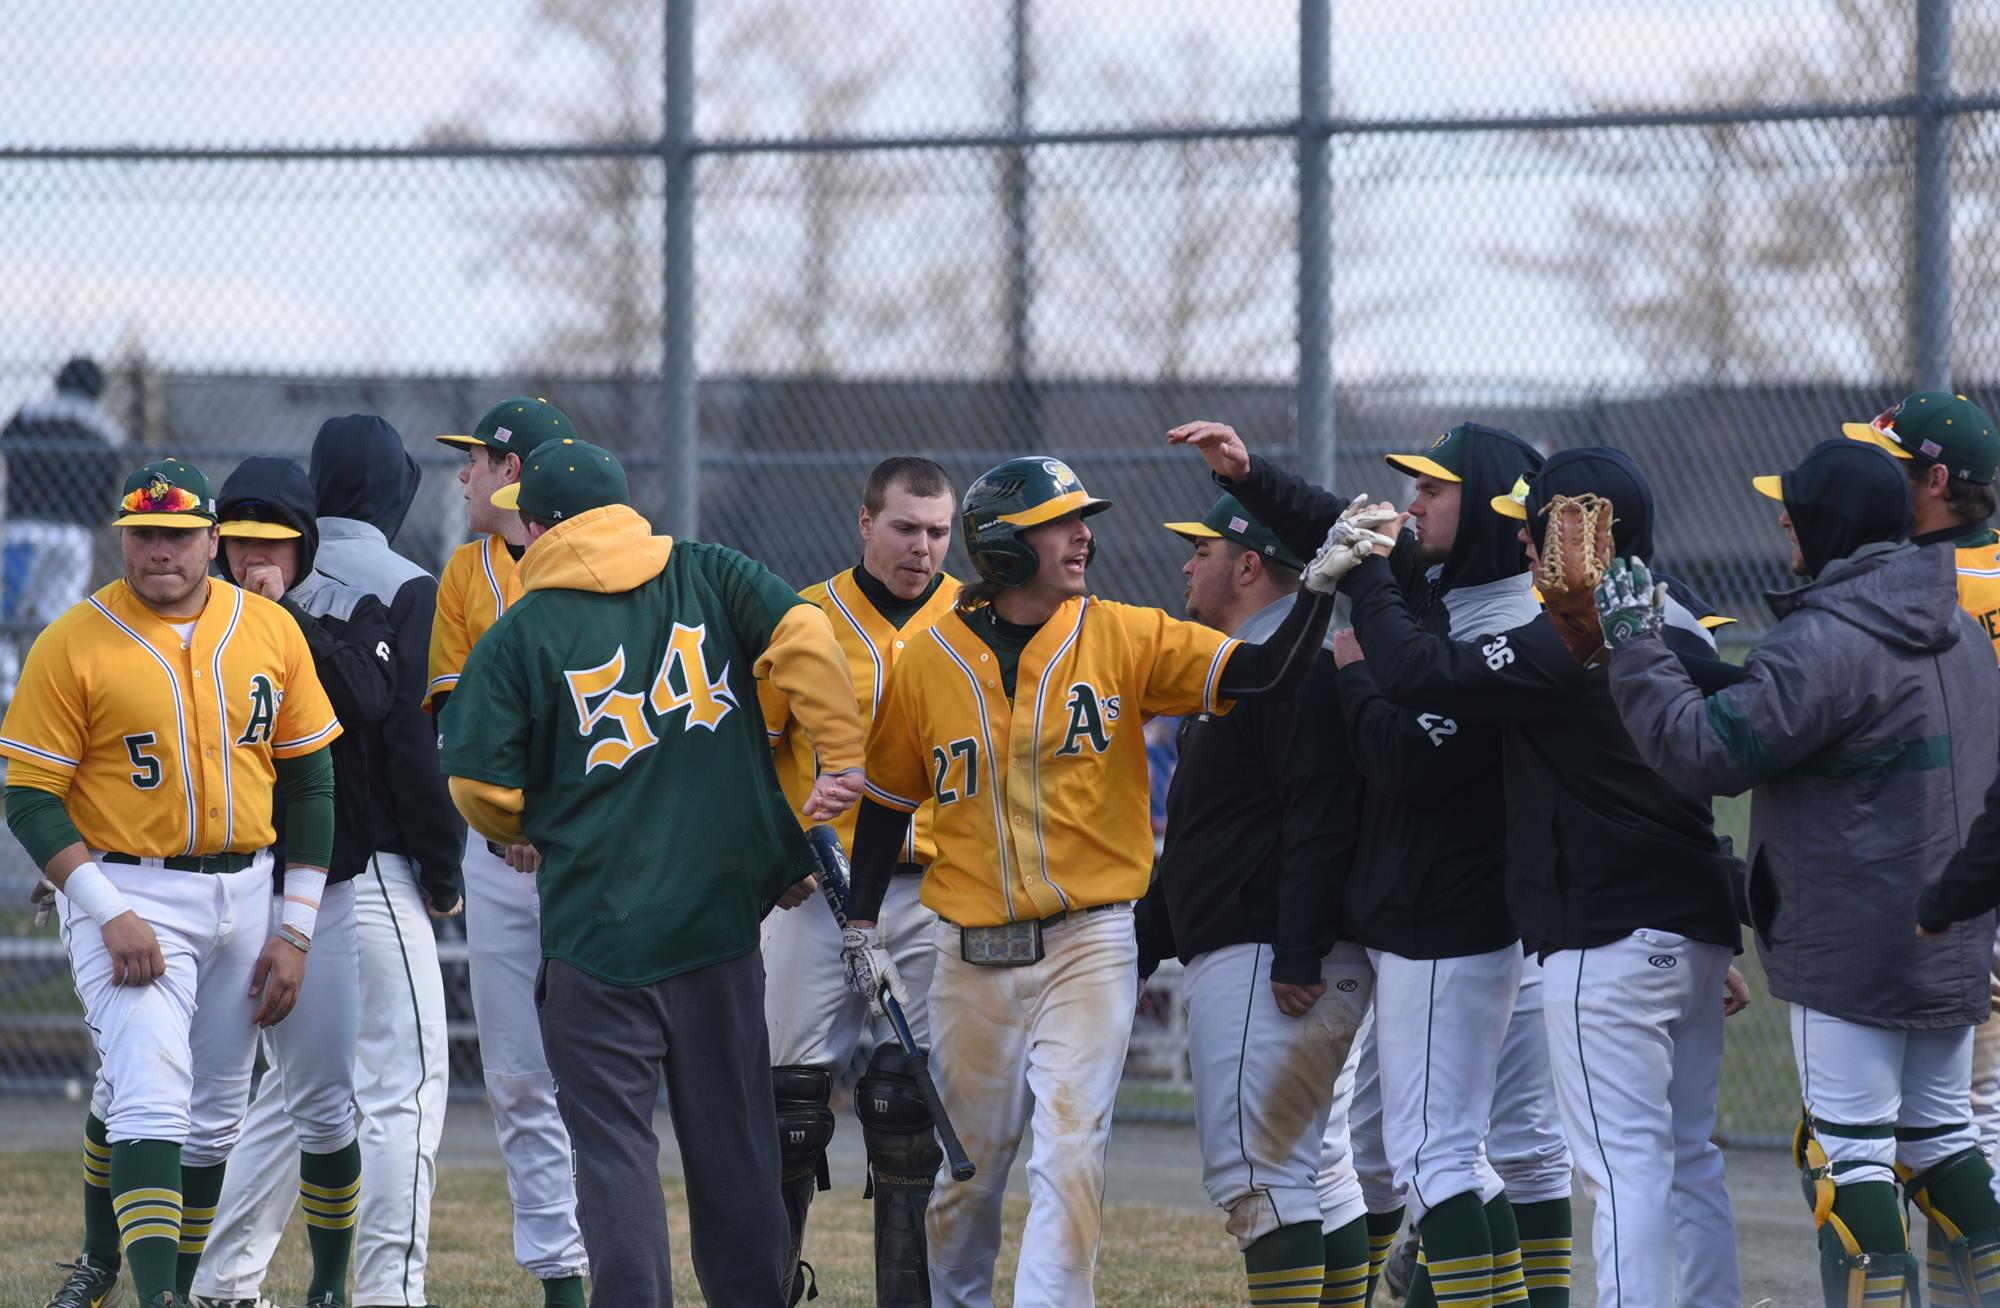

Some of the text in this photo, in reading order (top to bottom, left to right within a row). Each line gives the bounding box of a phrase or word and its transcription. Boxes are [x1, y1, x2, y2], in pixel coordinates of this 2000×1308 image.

[1482, 635, 1516, 671] 36
[234, 673, 285, 749] A's
[563, 621, 741, 776] 54
[1053, 682, 1121, 759] A's
[1416, 712, 1459, 747] 22
[122, 731, 162, 790] 5
[933, 736, 980, 807] 27
[886, 1174, 930, 1186] Wilson
